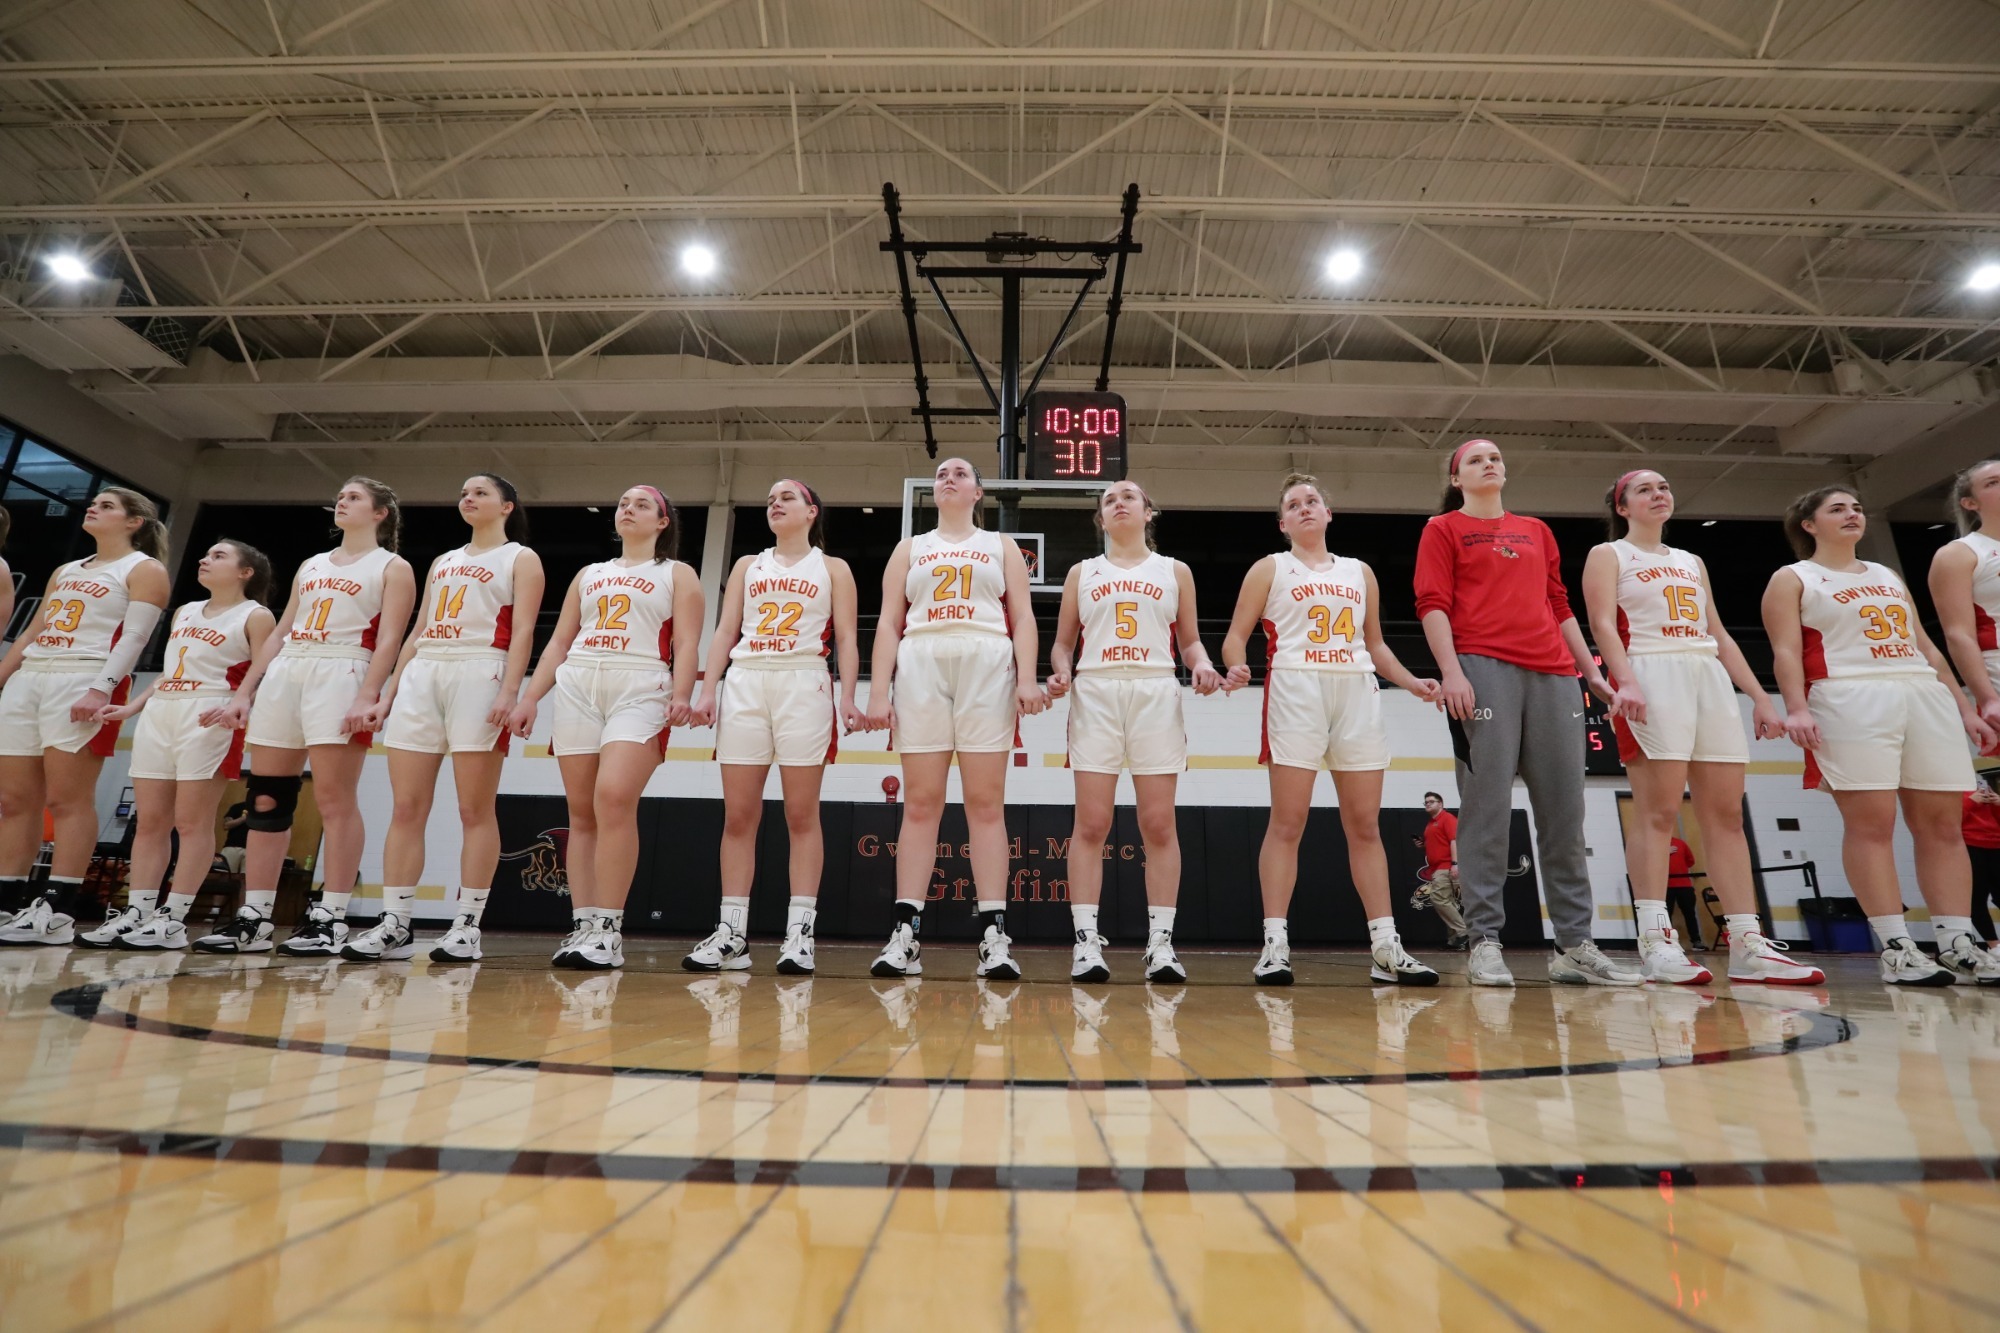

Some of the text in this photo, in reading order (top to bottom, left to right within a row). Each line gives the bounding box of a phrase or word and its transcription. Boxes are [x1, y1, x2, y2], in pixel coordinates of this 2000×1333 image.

[1046, 407, 1119, 434] 10:00
[1055, 439, 1100, 474] 30
[919, 550, 990, 566] GWYNEDD
[586, 576, 655, 594] GWYNEDD
[749, 577, 819, 598] GWYNEDD
[932, 564, 973, 601] 21
[1091, 581, 1164, 601] GWYNEDD
[1291, 583, 1361, 604] GWYNEDD
[46, 599, 85, 632] 23
[305, 597, 334, 630] 11
[435, 585, 468, 621] 14
[595, 594, 631, 630] 12
[757, 602, 804, 636] 22
[928, 605, 975, 622] MERCY
[1663, 585, 1699, 622] 15
[1116, 602, 1138, 639] 5
[1308, 605, 1355, 644] 34
[1859, 605, 1910, 640] 33
[173, 646, 188, 679] 1
[1102, 646, 1150, 662] MERCY
[1305, 649, 1354, 663] MERCY
[1474, 708, 1492, 720] 20
[1589, 732, 1603, 750] 5
